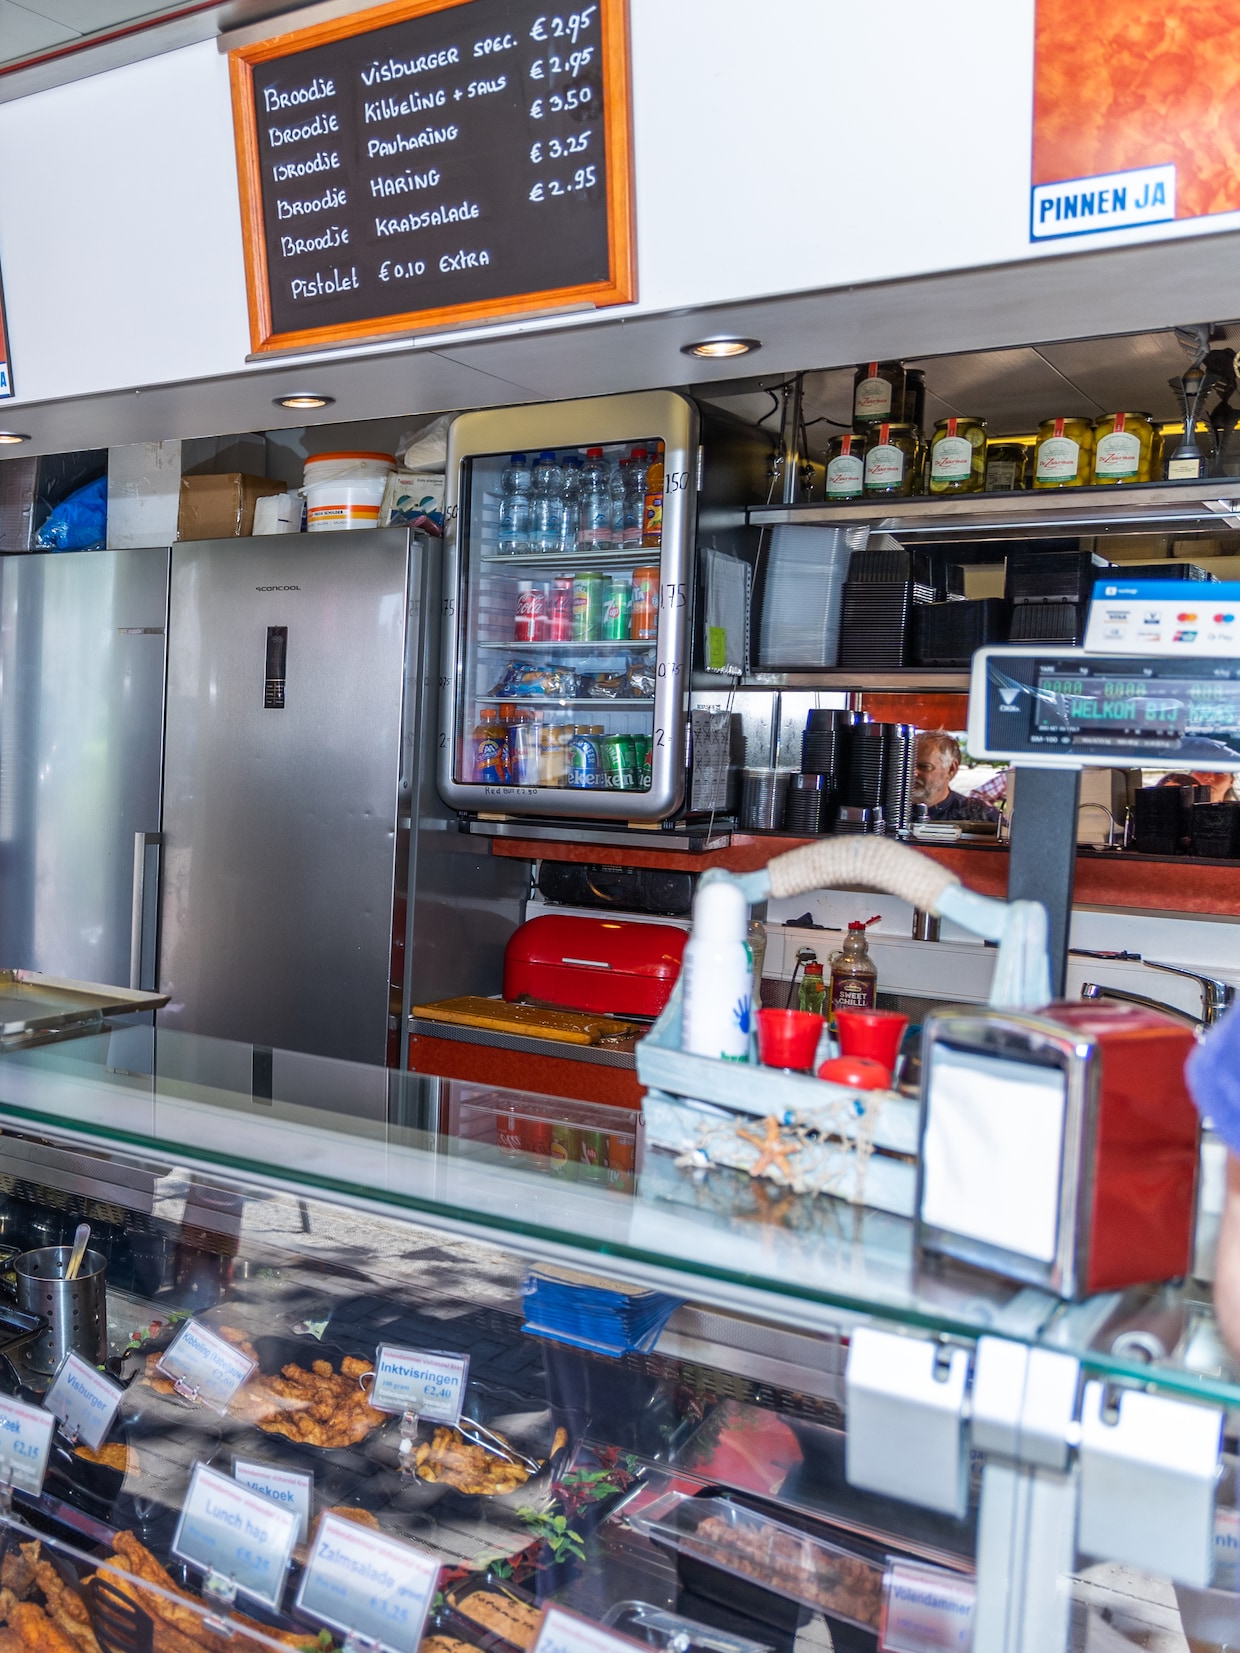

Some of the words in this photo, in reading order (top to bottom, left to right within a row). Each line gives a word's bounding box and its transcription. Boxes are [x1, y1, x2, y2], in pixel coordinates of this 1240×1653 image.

[453, 89, 463, 102] +
[370, 168, 441, 198] HARING
[1040, 187, 1127, 223] PINNEN
[1134, 181, 1166, 209] JA
[1071, 699, 1136, 719] WELKOM
[1145, 702, 1178, 721] BIJ
[839, 991, 868, 1000] SWEET
[839, 998, 867, 1007] CHILLI
[381, 1362, 458, 1385] Inktvisringen
[67, 1372, 107, 1412] Visburger
[205, 1499, 242, 1529] Lunch
[246, 1520, 268, 1543] hap
[318, 1542, 396, 1587] Zalmsalade
[894, 1585, 971, 1614] Volendammer
